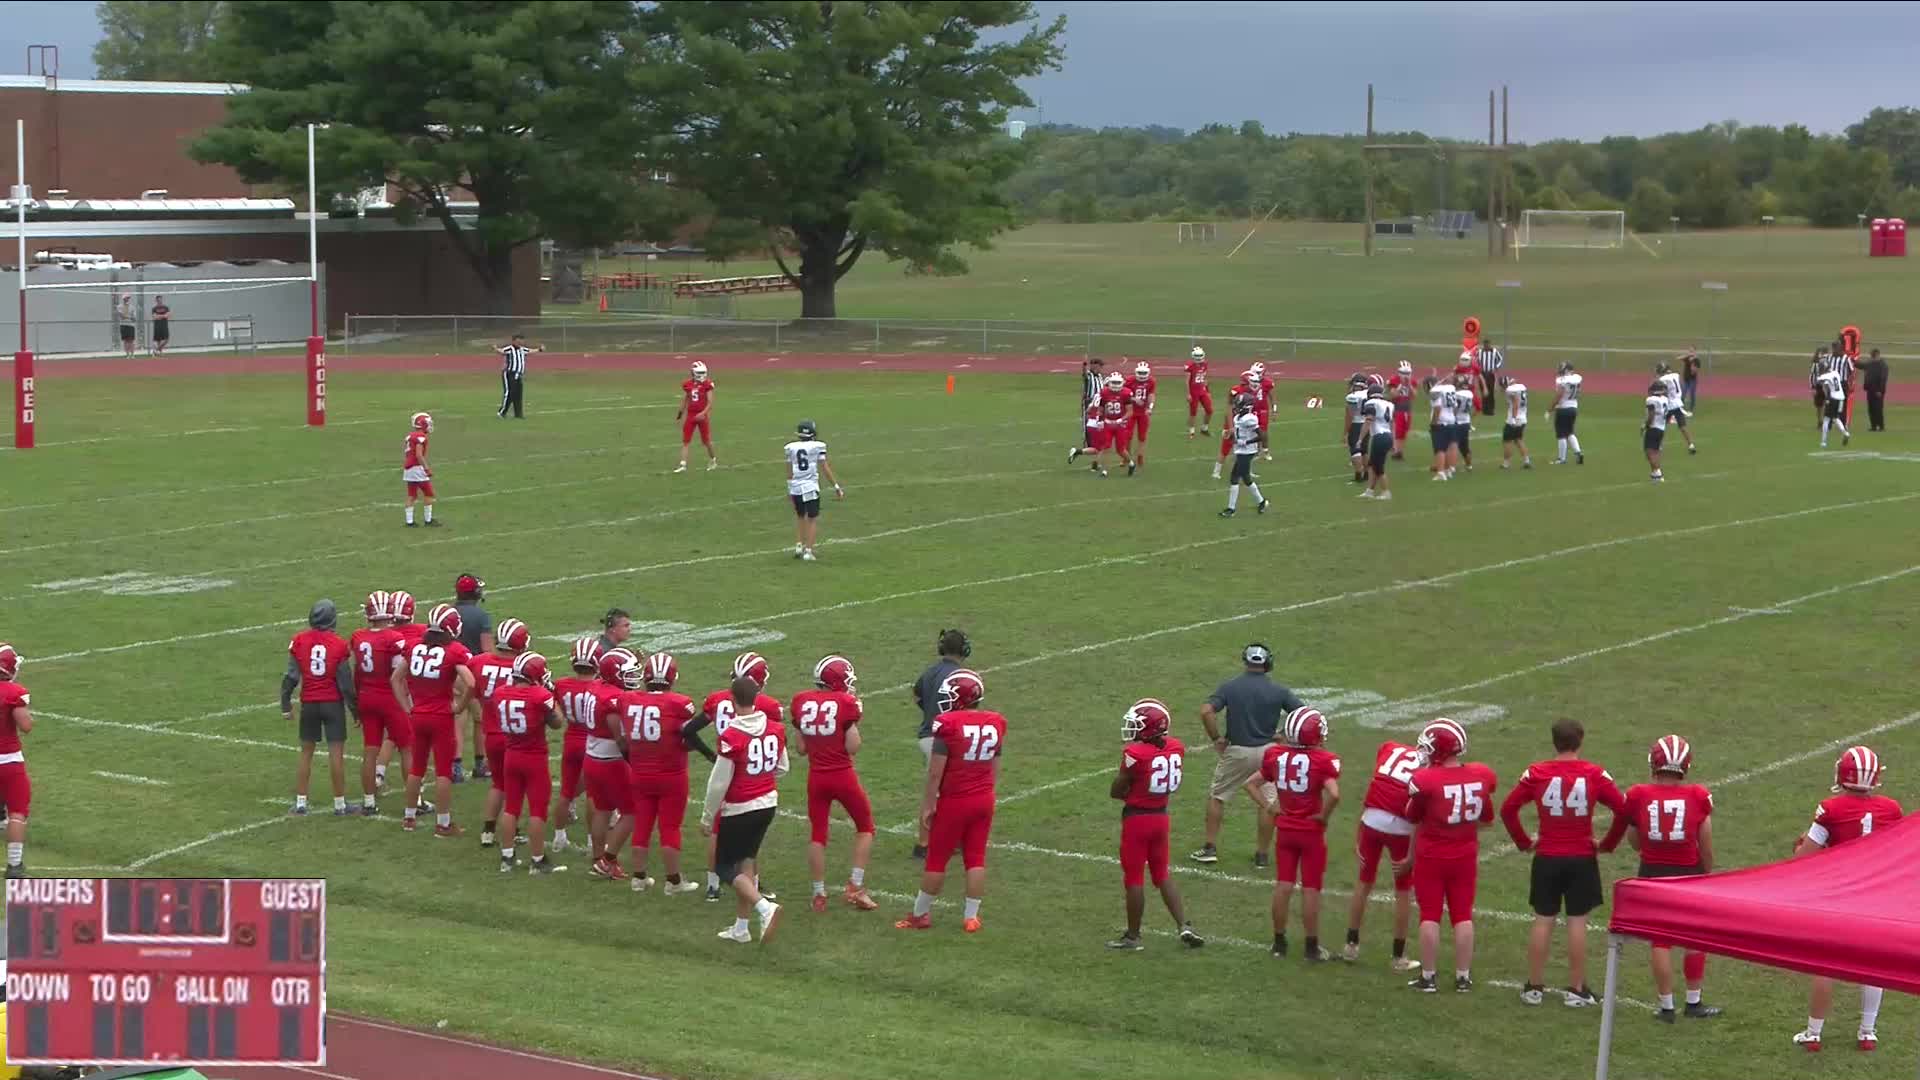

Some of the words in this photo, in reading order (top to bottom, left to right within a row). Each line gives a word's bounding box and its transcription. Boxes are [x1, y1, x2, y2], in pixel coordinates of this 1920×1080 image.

[23, 378, 34, 423] RED
[316, 353, 326, 411] HOOK
[691, 390, 700, 401] 5
[796, 449, 809, 471] 6
[310, 644, 327, 676] 8
[359, 642, 374, 673] 3
[410, 644, 445, 679] 62
[498, 700, 527, 734] 15
[627, 705, 661, 741] 76
[800, 701, 838, 736] 23
[746, 735, 779, 775] 99
[963, 724, 999, 761] 72
[1150, 753, 1182, 793] 26
[1277, 752, 1311, 793] 13
[1378, 747, 1420, 784] 12
[1443, 782, 1483, 823] 75
[1541, 776, 1588, 817] 44
[1647, 799, 1686, 840] 17
